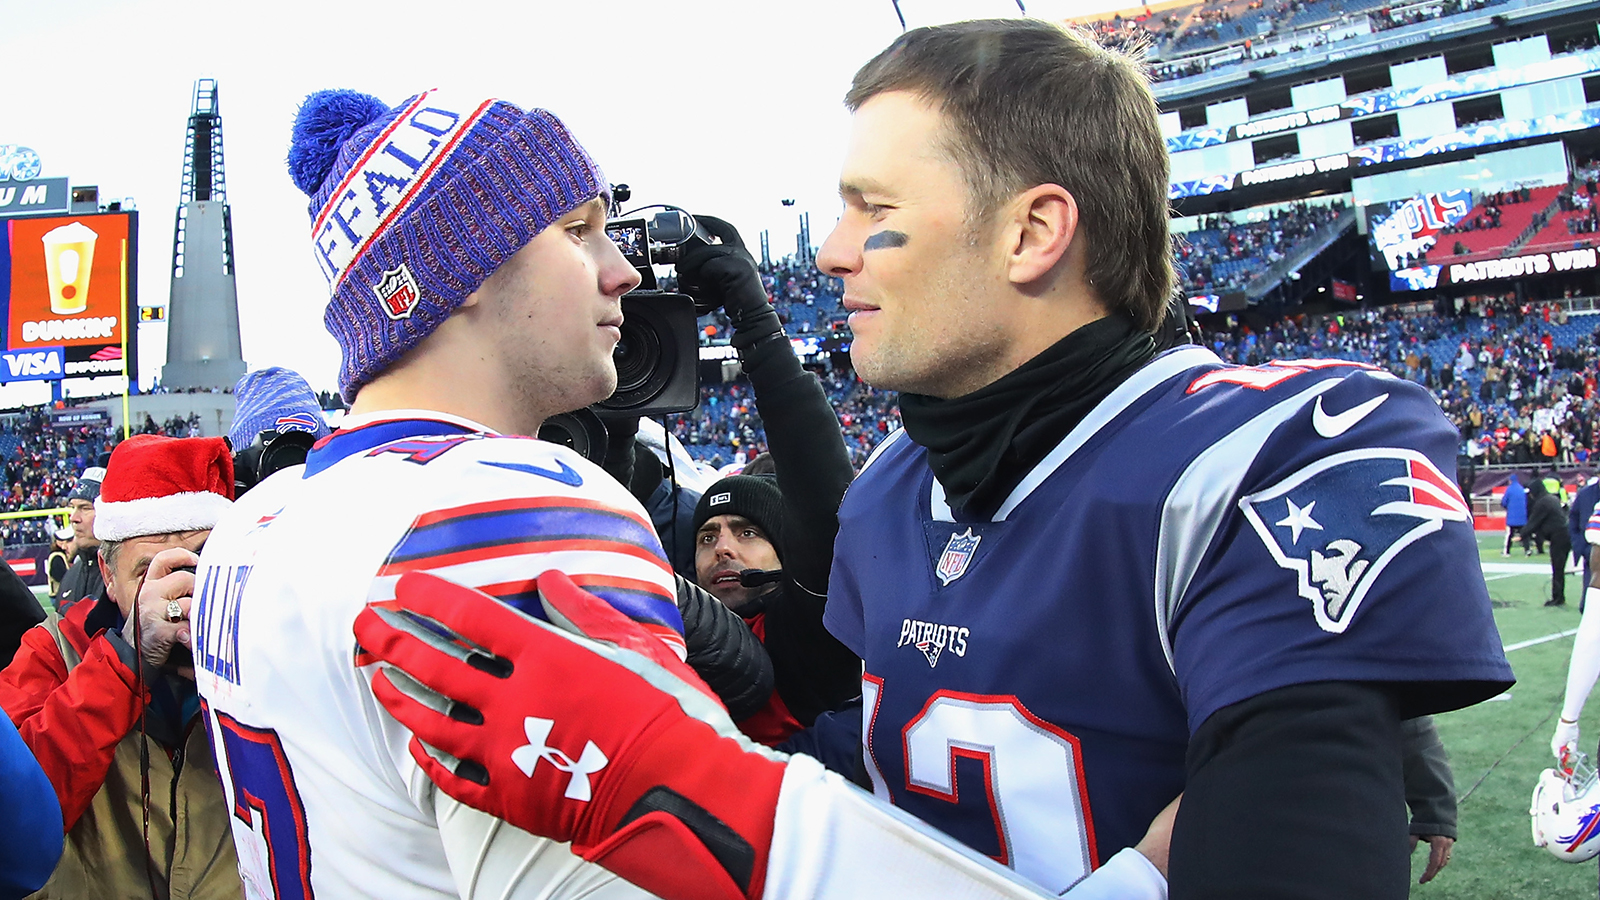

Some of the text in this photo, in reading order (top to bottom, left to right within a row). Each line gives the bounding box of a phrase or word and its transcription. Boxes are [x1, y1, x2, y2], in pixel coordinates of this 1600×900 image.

[1236, 106, 1340, 138] PATRIOTS WIN
[1242, 154, 1349, 185] PATRIOTS WIN
[1450, 248, 1596, 283] PATRIOTS WIN
[2, 351, 61, 377] VISA
[941, 552, 967, 574] NFL
[197, 564, 254, 687] ALLEN
[897, 618, 970, 658] PATRIOTS
